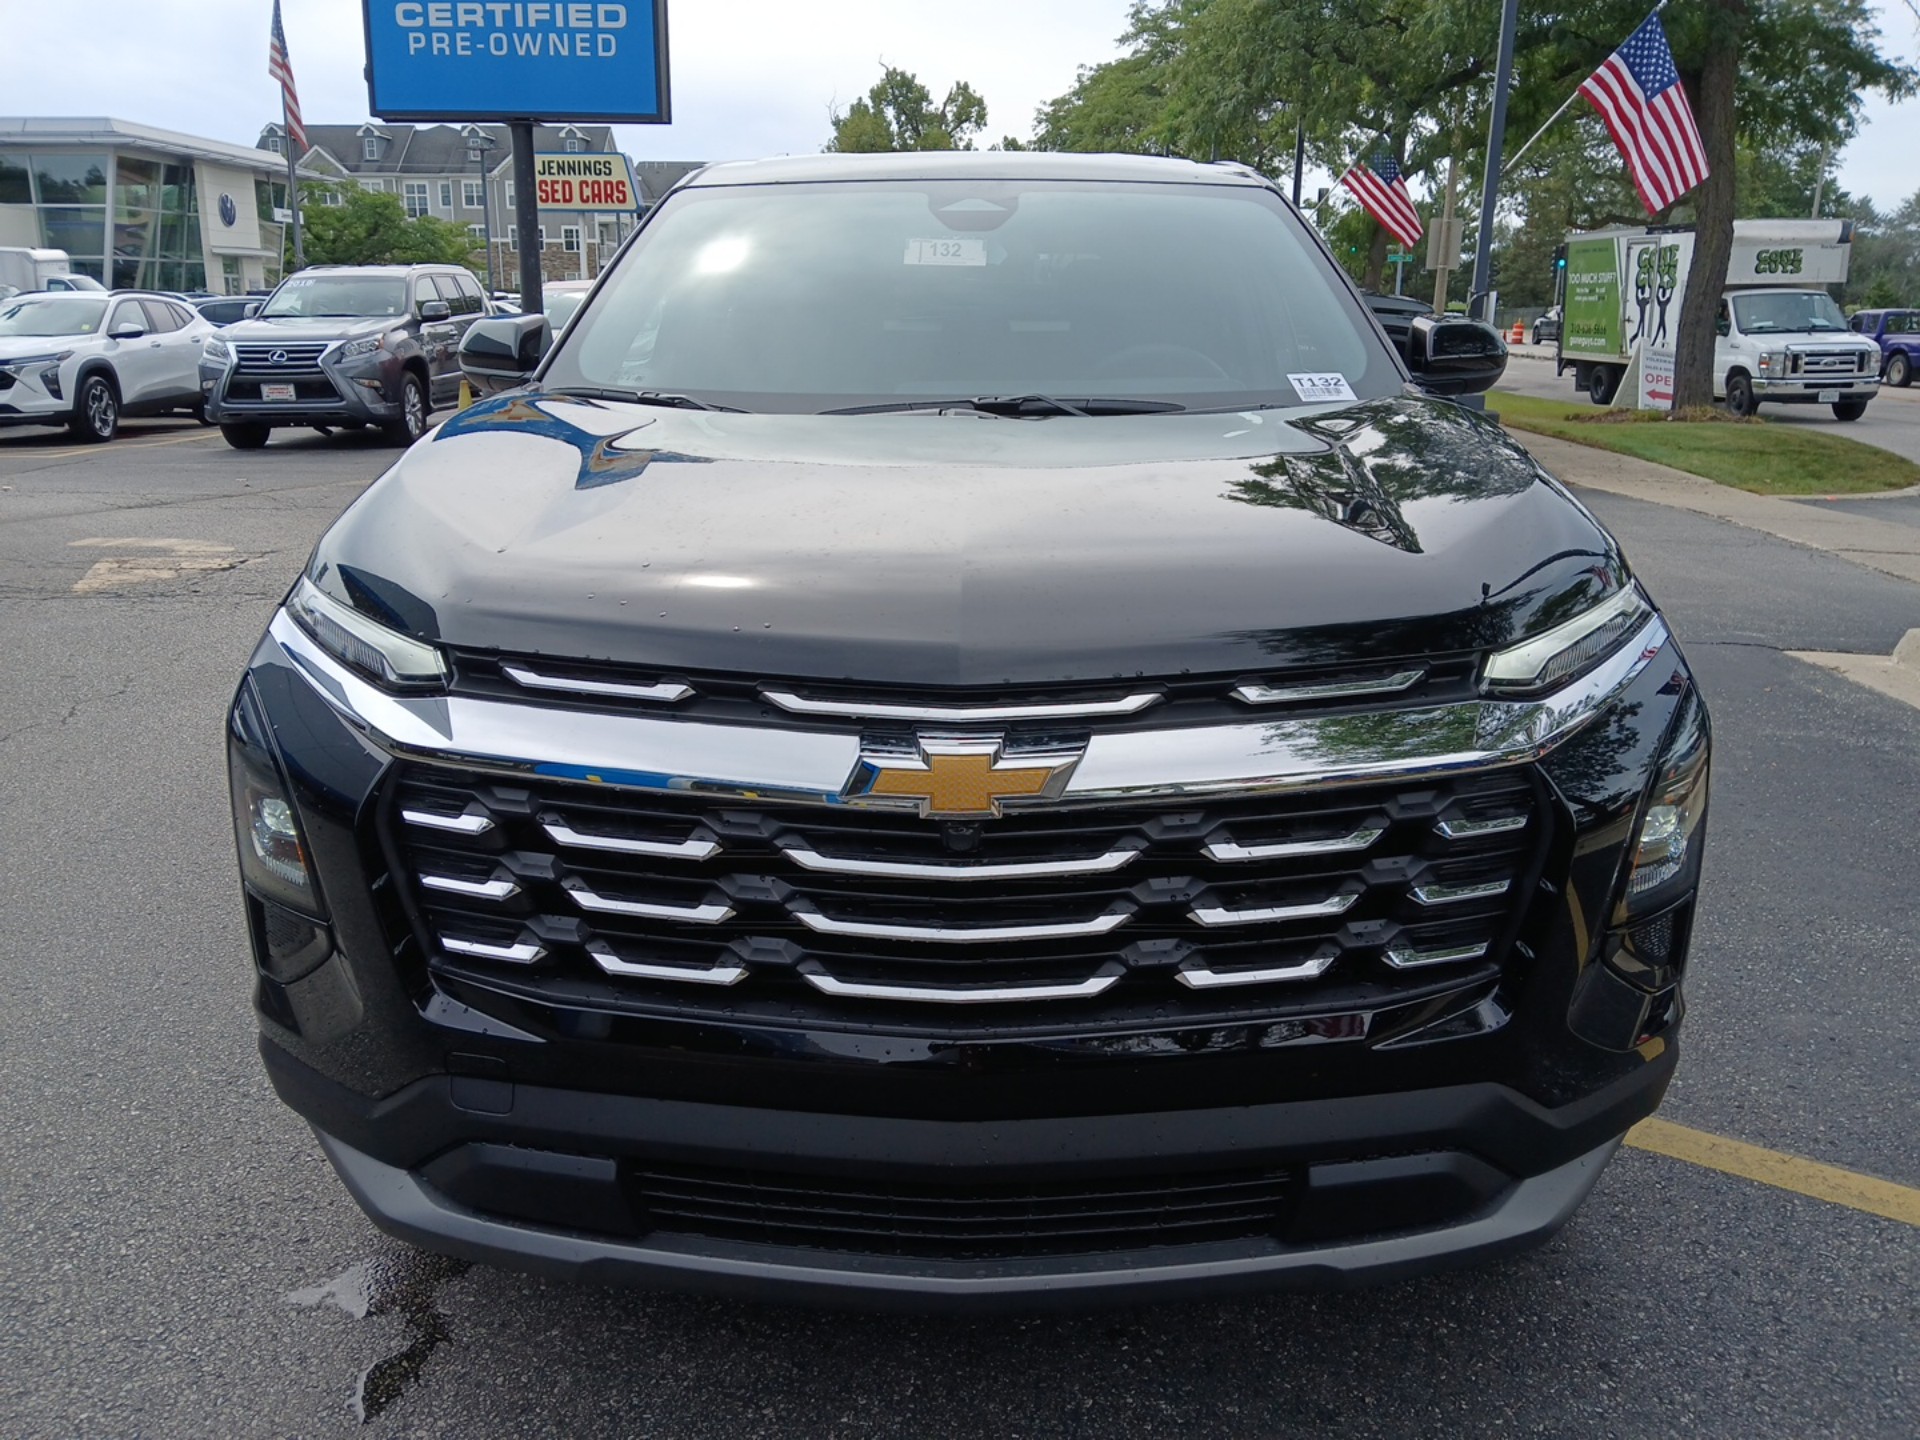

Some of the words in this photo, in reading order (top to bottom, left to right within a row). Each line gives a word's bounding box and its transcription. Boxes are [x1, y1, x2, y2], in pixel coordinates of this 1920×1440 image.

[395, 2, 627, 29] CERTIFIED
[408, 32, 617, 57] PRE-OWNED
[538, 160, 612, 176] JENNINGS
[538, 180, 573, 204] SED
[579, 180, 627, 204] CARS
[1637, 244, 1680, 268] GONE
[1756, 248, 1803, 263] GONE
[1754, 260, 1803, 274] GUYS
[1636, 266, 1677, 289] GUYS
[1293, 376, 1344, 388] T132
[1645, 372, 1672, 387] OPE
